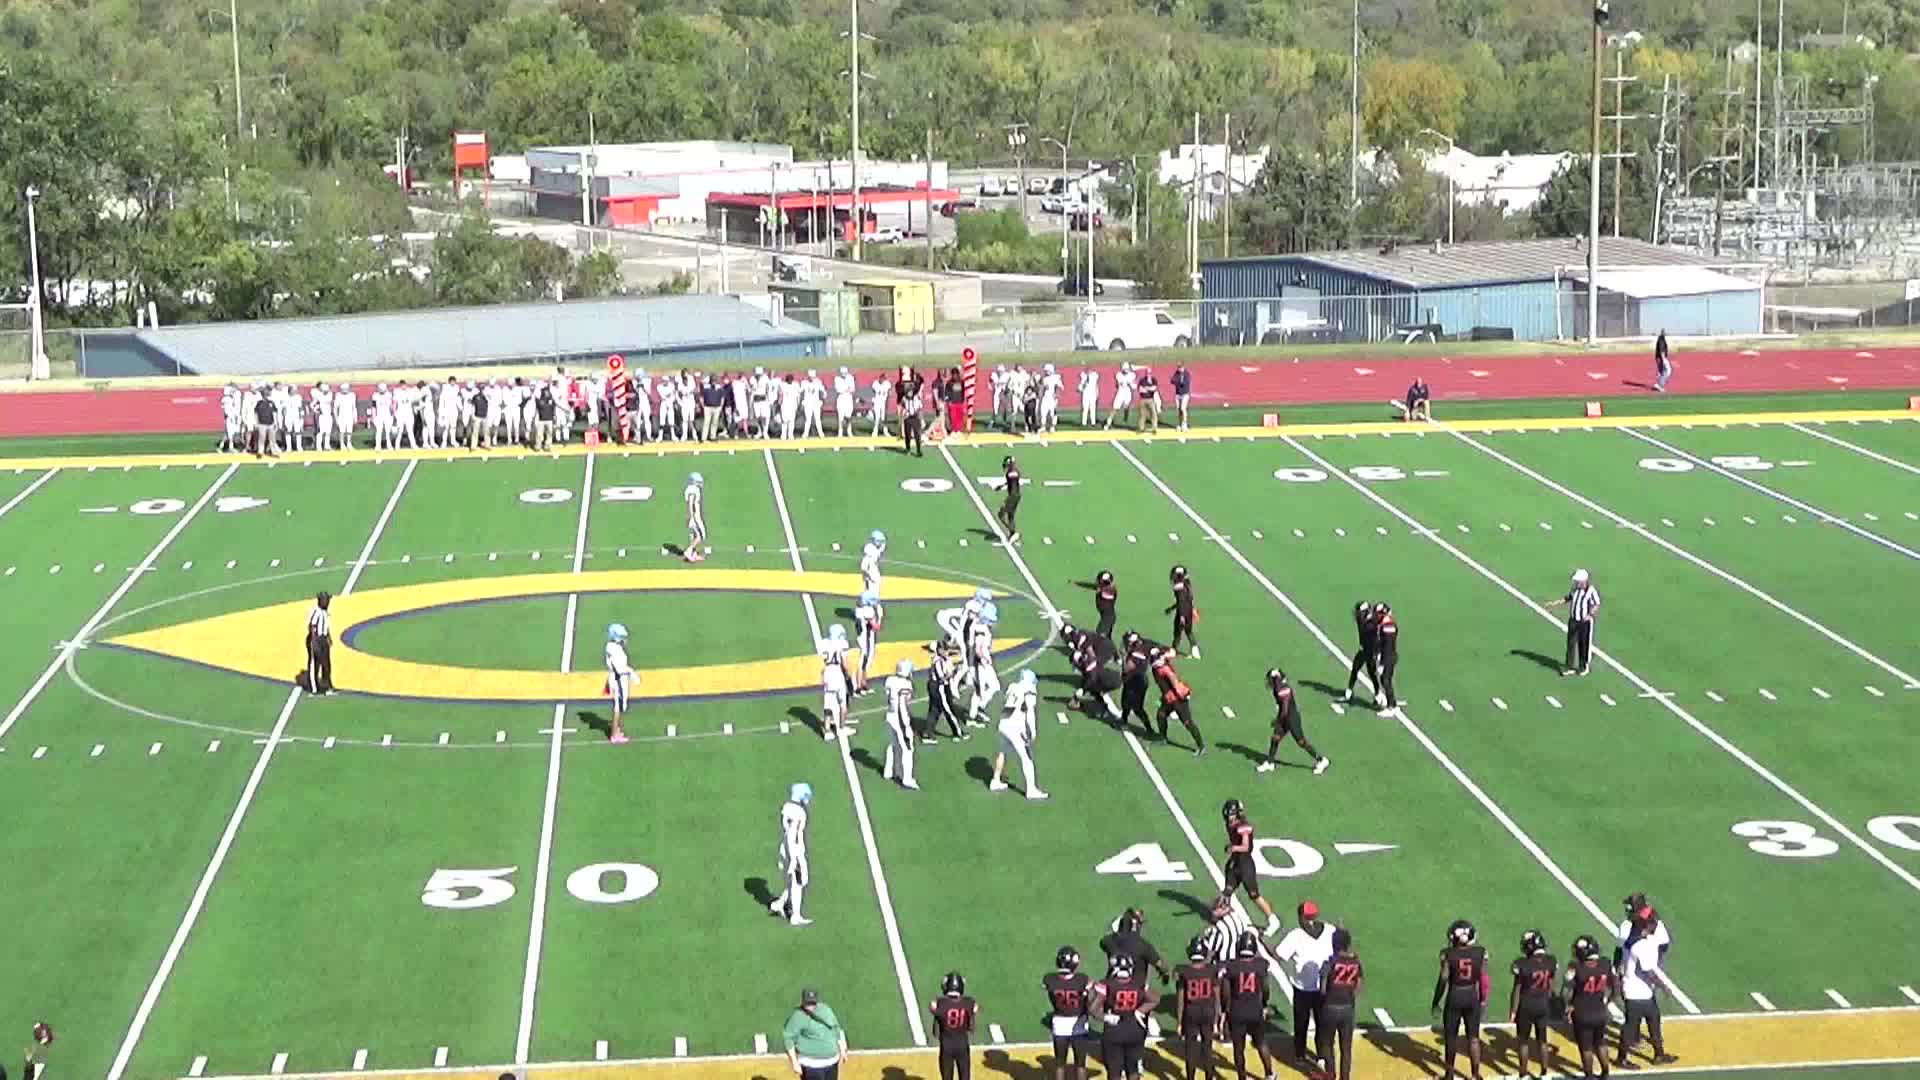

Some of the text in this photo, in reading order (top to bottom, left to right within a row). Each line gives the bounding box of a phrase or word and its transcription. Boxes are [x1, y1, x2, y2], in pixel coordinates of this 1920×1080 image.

[1334, 963, 1360, 986] 22
[1456, 958, 1473, 980] 5
[1238, 972, 1257, 994] 14
